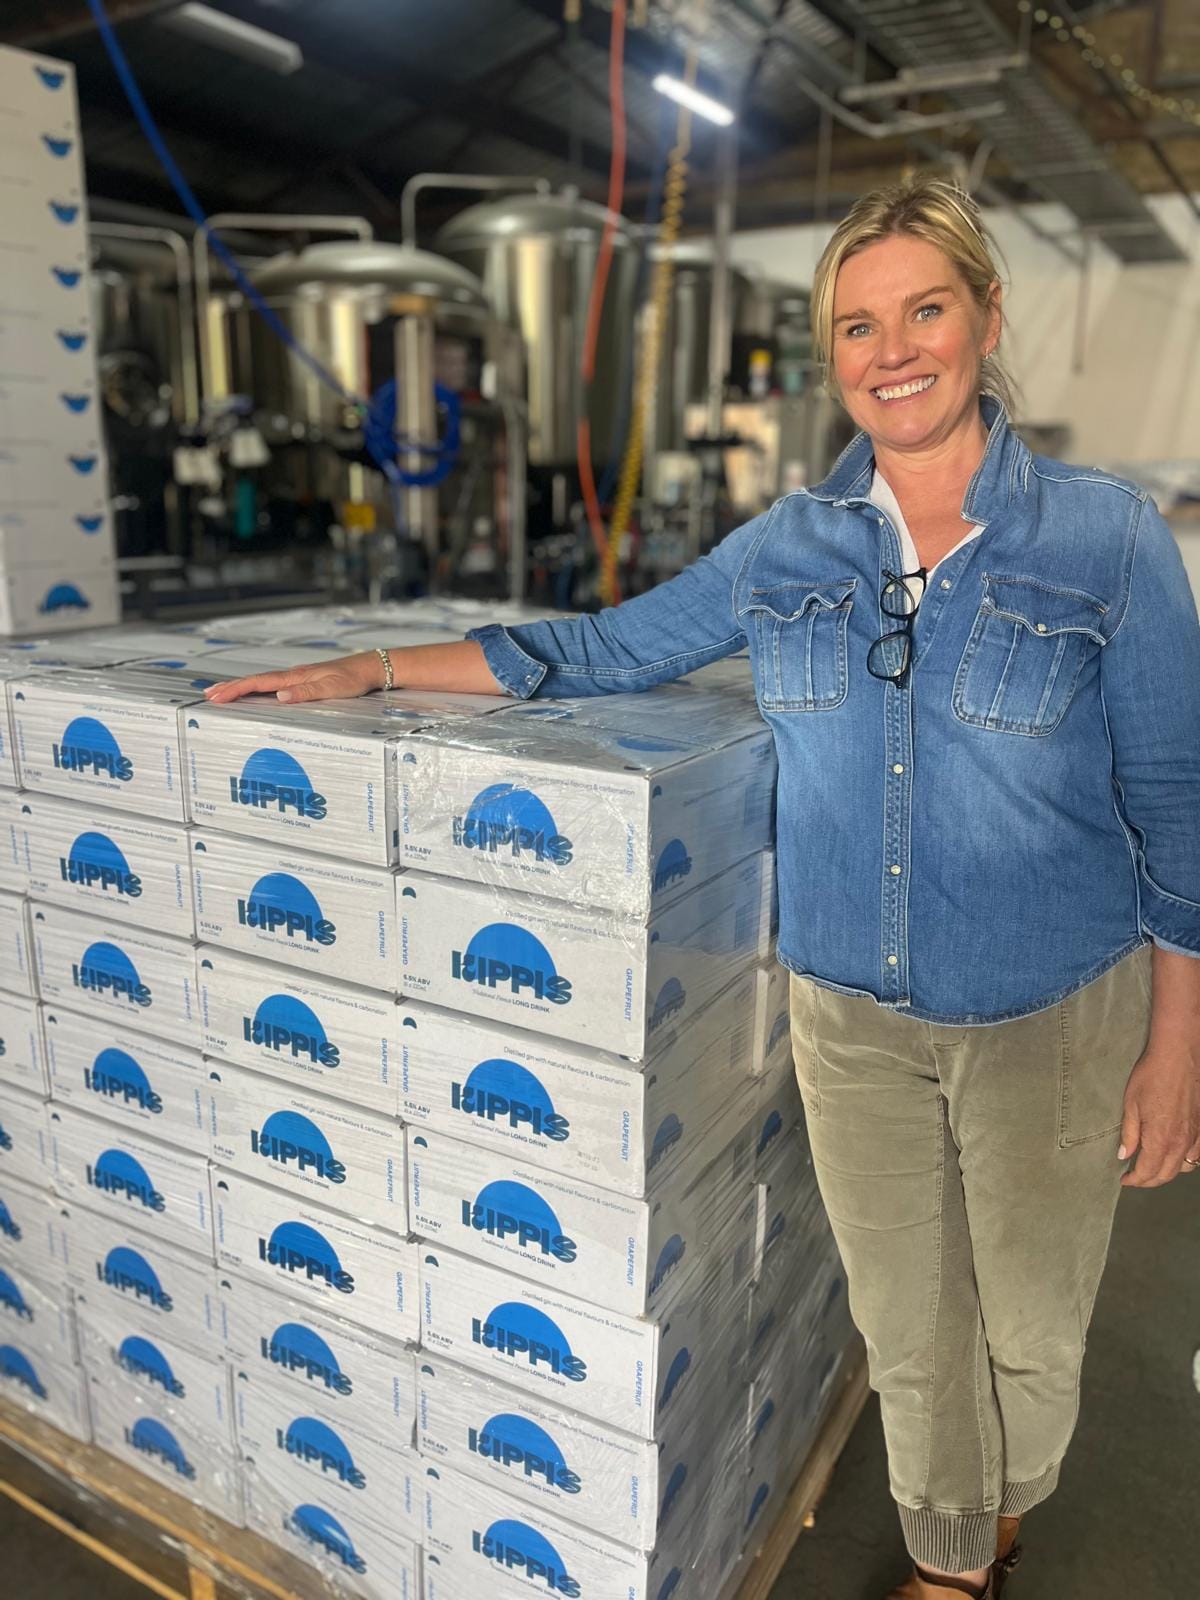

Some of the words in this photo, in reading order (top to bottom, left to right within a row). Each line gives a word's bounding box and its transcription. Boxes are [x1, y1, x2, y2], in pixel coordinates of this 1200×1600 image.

[52, 744, 134, 782] KIPPIS
[230, 776, 327, 821] KIPPIS
[452, 816, 574, 867] KIPPIS
[60, 857, 143, 898] KIPPIS
[513, 863, 531, 872] LNG
[238, 899, 337, 946] KIPPIS
[72, 964, 153, 1008] KIPPIS
[452, 950, 573, 1005] KIPPIS
[625, 967, 633, 1021] GRAPEFRUIT
[513, 999, 530, 1008] LONG
[243, 1017, 341, 1069] KIPPIS
[84, 1067, 164, 1115] KIPPIS
[568, 1064, 589, 1076] flavours
[451, 1082, 570, 1142] KIPPIS
[621, 1111, 629, 1161] GRAPEFRUIT
[251, 1129, 347, 1184] KIPPIS
[511, 1133, 528, 1143] LONG
[86, 1164, 166, 1213] KIPPIS
[462, 1200, 577, 1263] KIPPIS
[258, 1237, 356, 1295] KIPPIS
[627, 1236, 635, 1286] GRAPEFRUIT
[261, 1336, 353, 1396] KIPPIS
[473, 1318, 587, 1382] KIPPIS
[276, 1427, 367, 1490] KIPPIS
[468, 1427, 582, 1495] KIPPIS
[472, 1529, 581, 1599] KIPPIS
